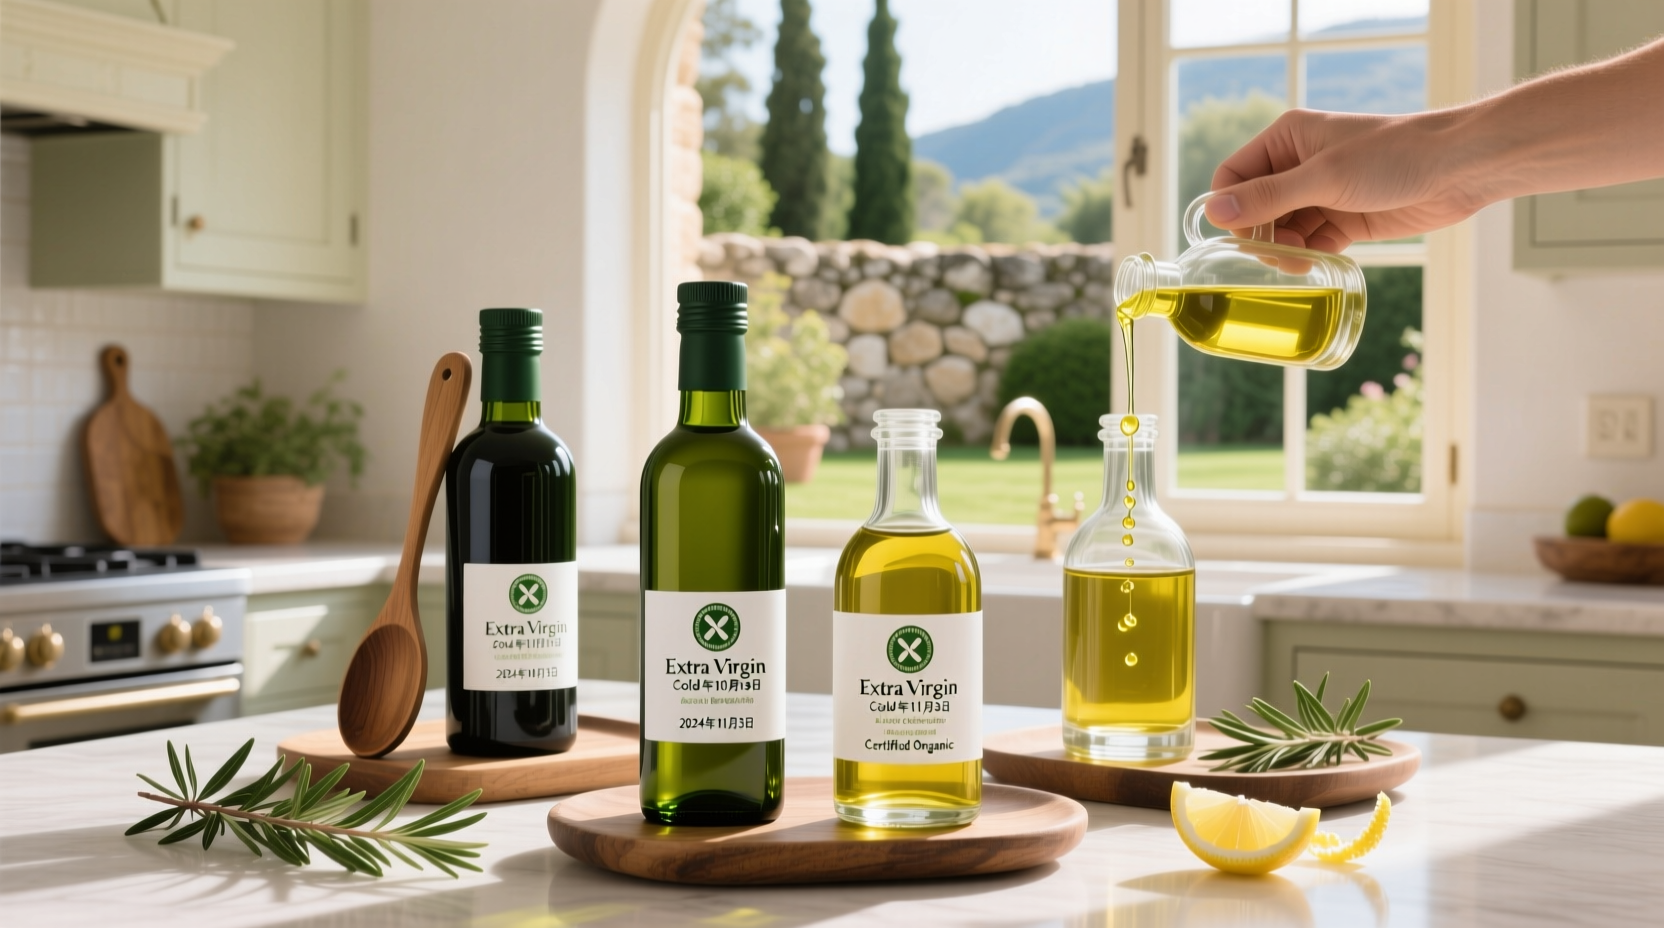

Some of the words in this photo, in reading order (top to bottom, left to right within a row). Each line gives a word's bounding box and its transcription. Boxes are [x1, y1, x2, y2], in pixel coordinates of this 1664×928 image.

[485, 621, 524, 636] Extra
[527, 620, 567, 638] Virgin
[666, 658, 710, 675] Extra
[713, 658, 766, 679] Virgin
[673, 679, 700, 691] Cold
[860, 679, 903, 696] Extra
[906, 678, 957, 700] Virgin
[679, 716, 754, 730] 2024年11月3日
